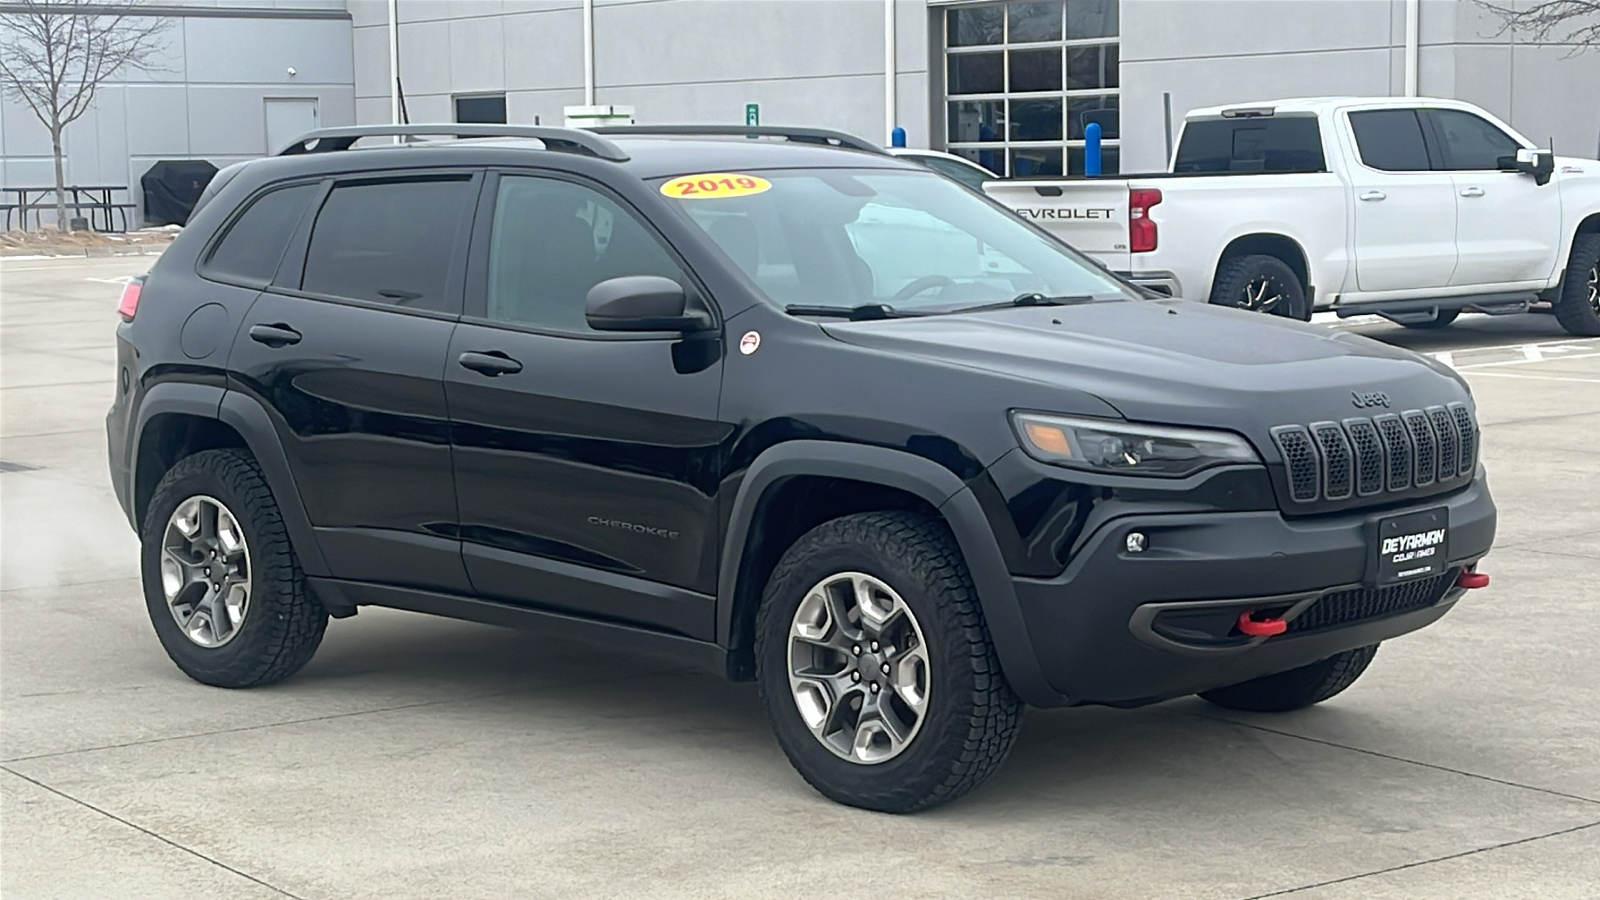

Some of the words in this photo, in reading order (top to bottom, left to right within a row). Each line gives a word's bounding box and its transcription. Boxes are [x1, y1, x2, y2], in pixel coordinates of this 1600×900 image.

[676, 177, 756, 196] 2019
[1013, 208, 1115, 219] EVROLET
[1351, 391, 1390, 409] Jeep
[587, 516, 680, 539] CHEROKEE
[1382, 529, 1445, 555] DEYARMAN
